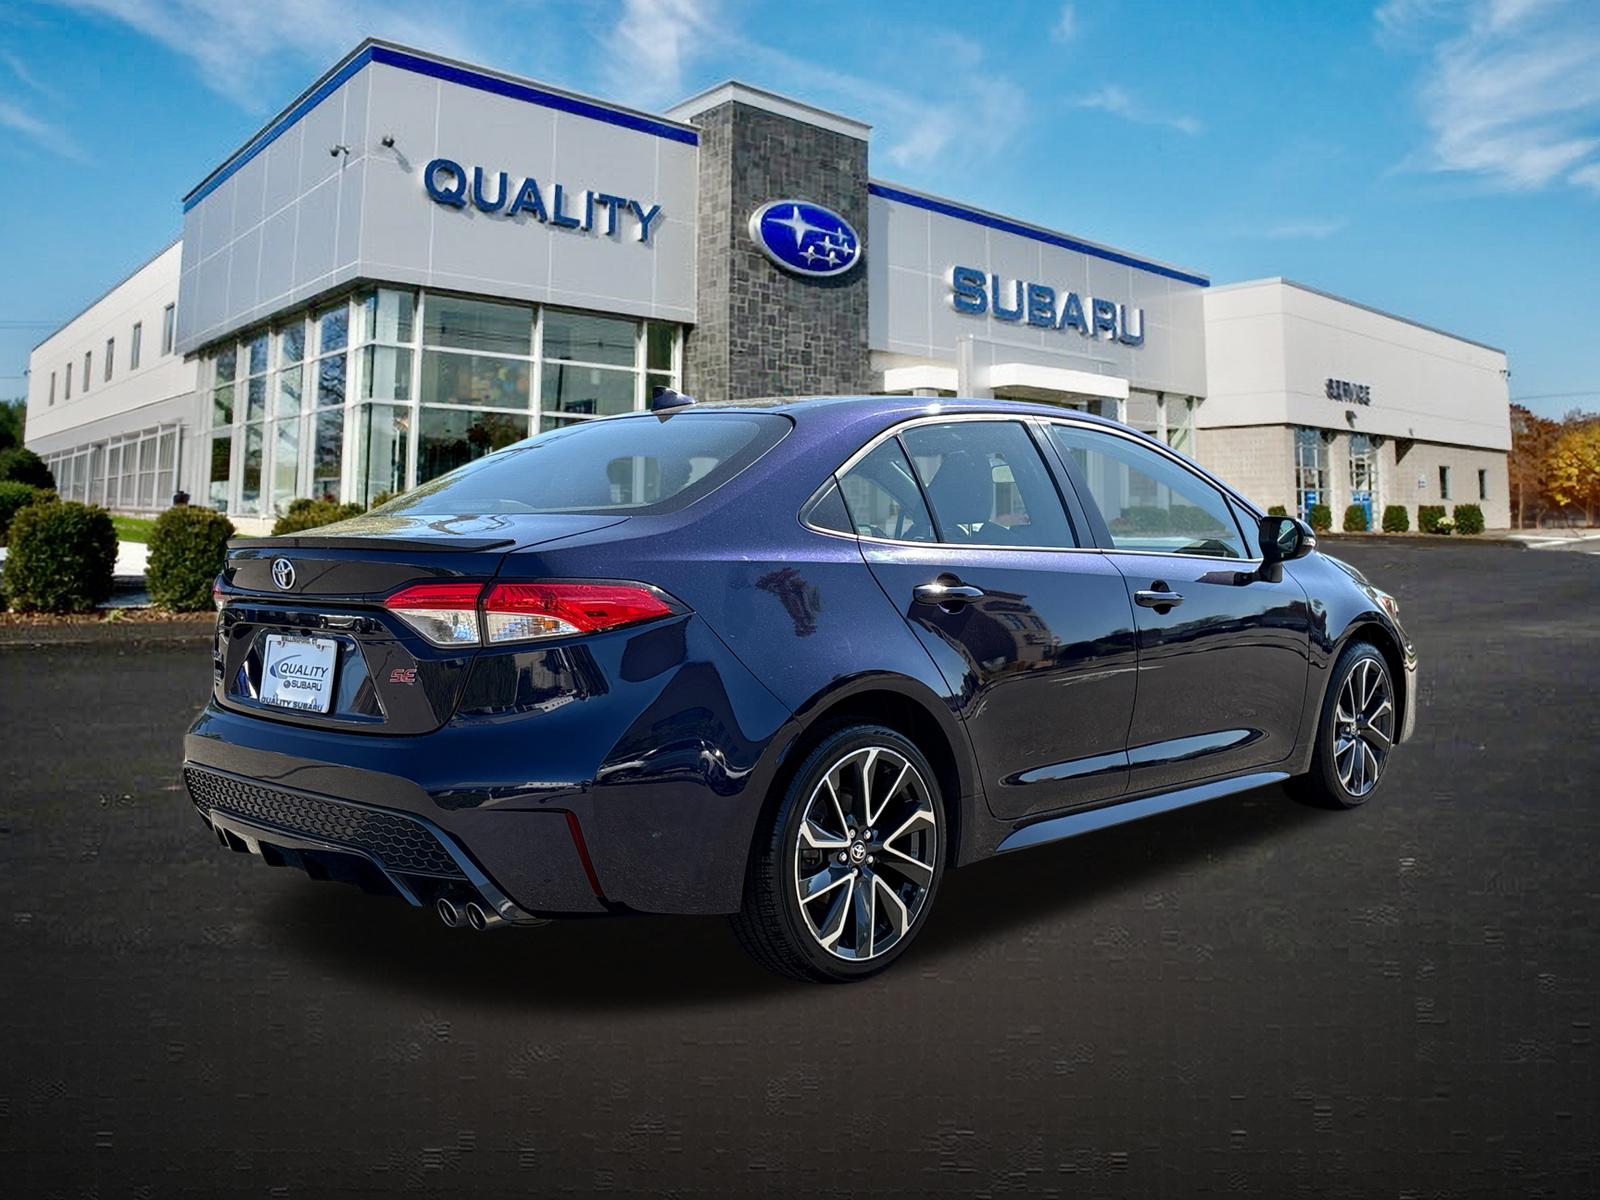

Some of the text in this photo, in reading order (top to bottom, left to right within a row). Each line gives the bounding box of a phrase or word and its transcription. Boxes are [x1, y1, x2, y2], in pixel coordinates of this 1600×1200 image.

[424, 158, 662, 242] QUALITY
[952, 265, 1145, 347] SUBARU
[1325, 378, 1370, 405] SERVICE
[280, 662, 328, 678] QUALITY
[390, 668, 417, 683] SE
[291, 679, 322, 691] SUBARU
[261, 696, 323, 711] QUALITY SUBARU
